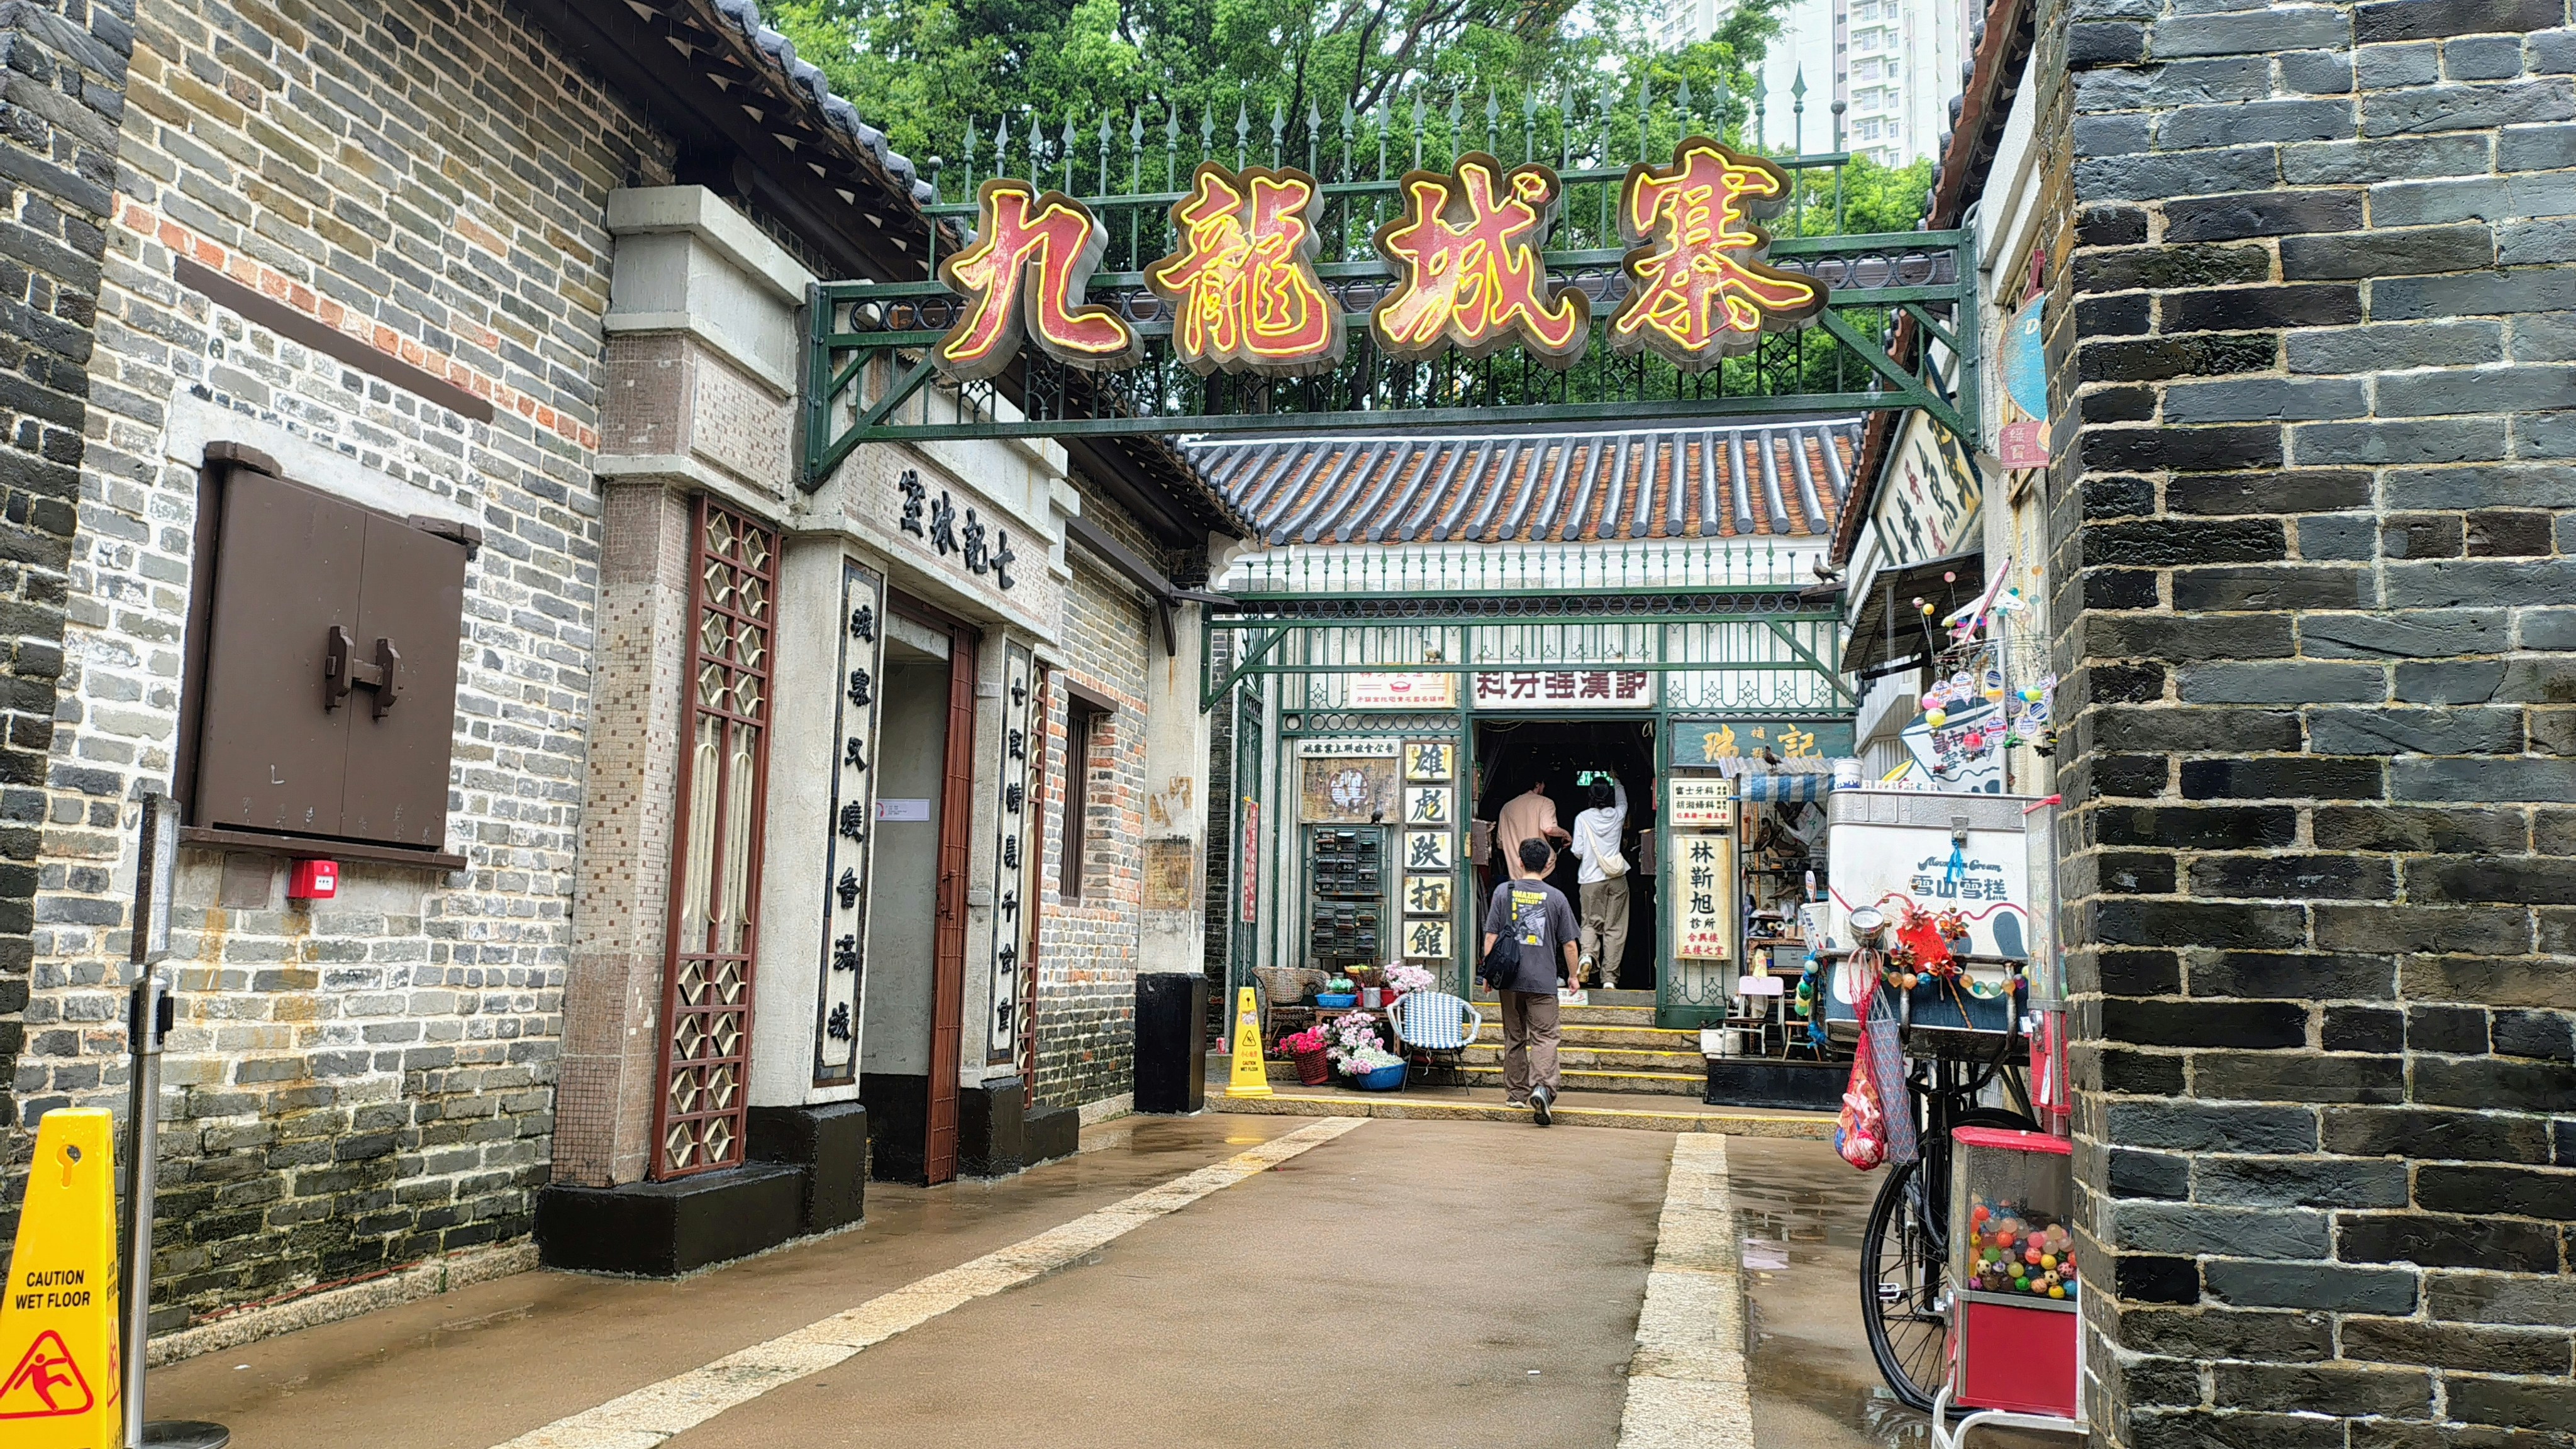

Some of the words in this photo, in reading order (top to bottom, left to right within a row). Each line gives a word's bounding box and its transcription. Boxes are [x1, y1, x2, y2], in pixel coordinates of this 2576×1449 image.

[942, 145, 1818, 360] 九龍城寨
[1409, 744, 1447, 956] 雄彪跌打館
[1911, 874, 2008, 901] 雪山雪糕
[1689, 917, 1716, 930] 診所
[26, 1269, 84, 1287] CAUTION
[16, 1293, 43, 1309] WET
[47, 1291, 91, 1308] FLOOR
